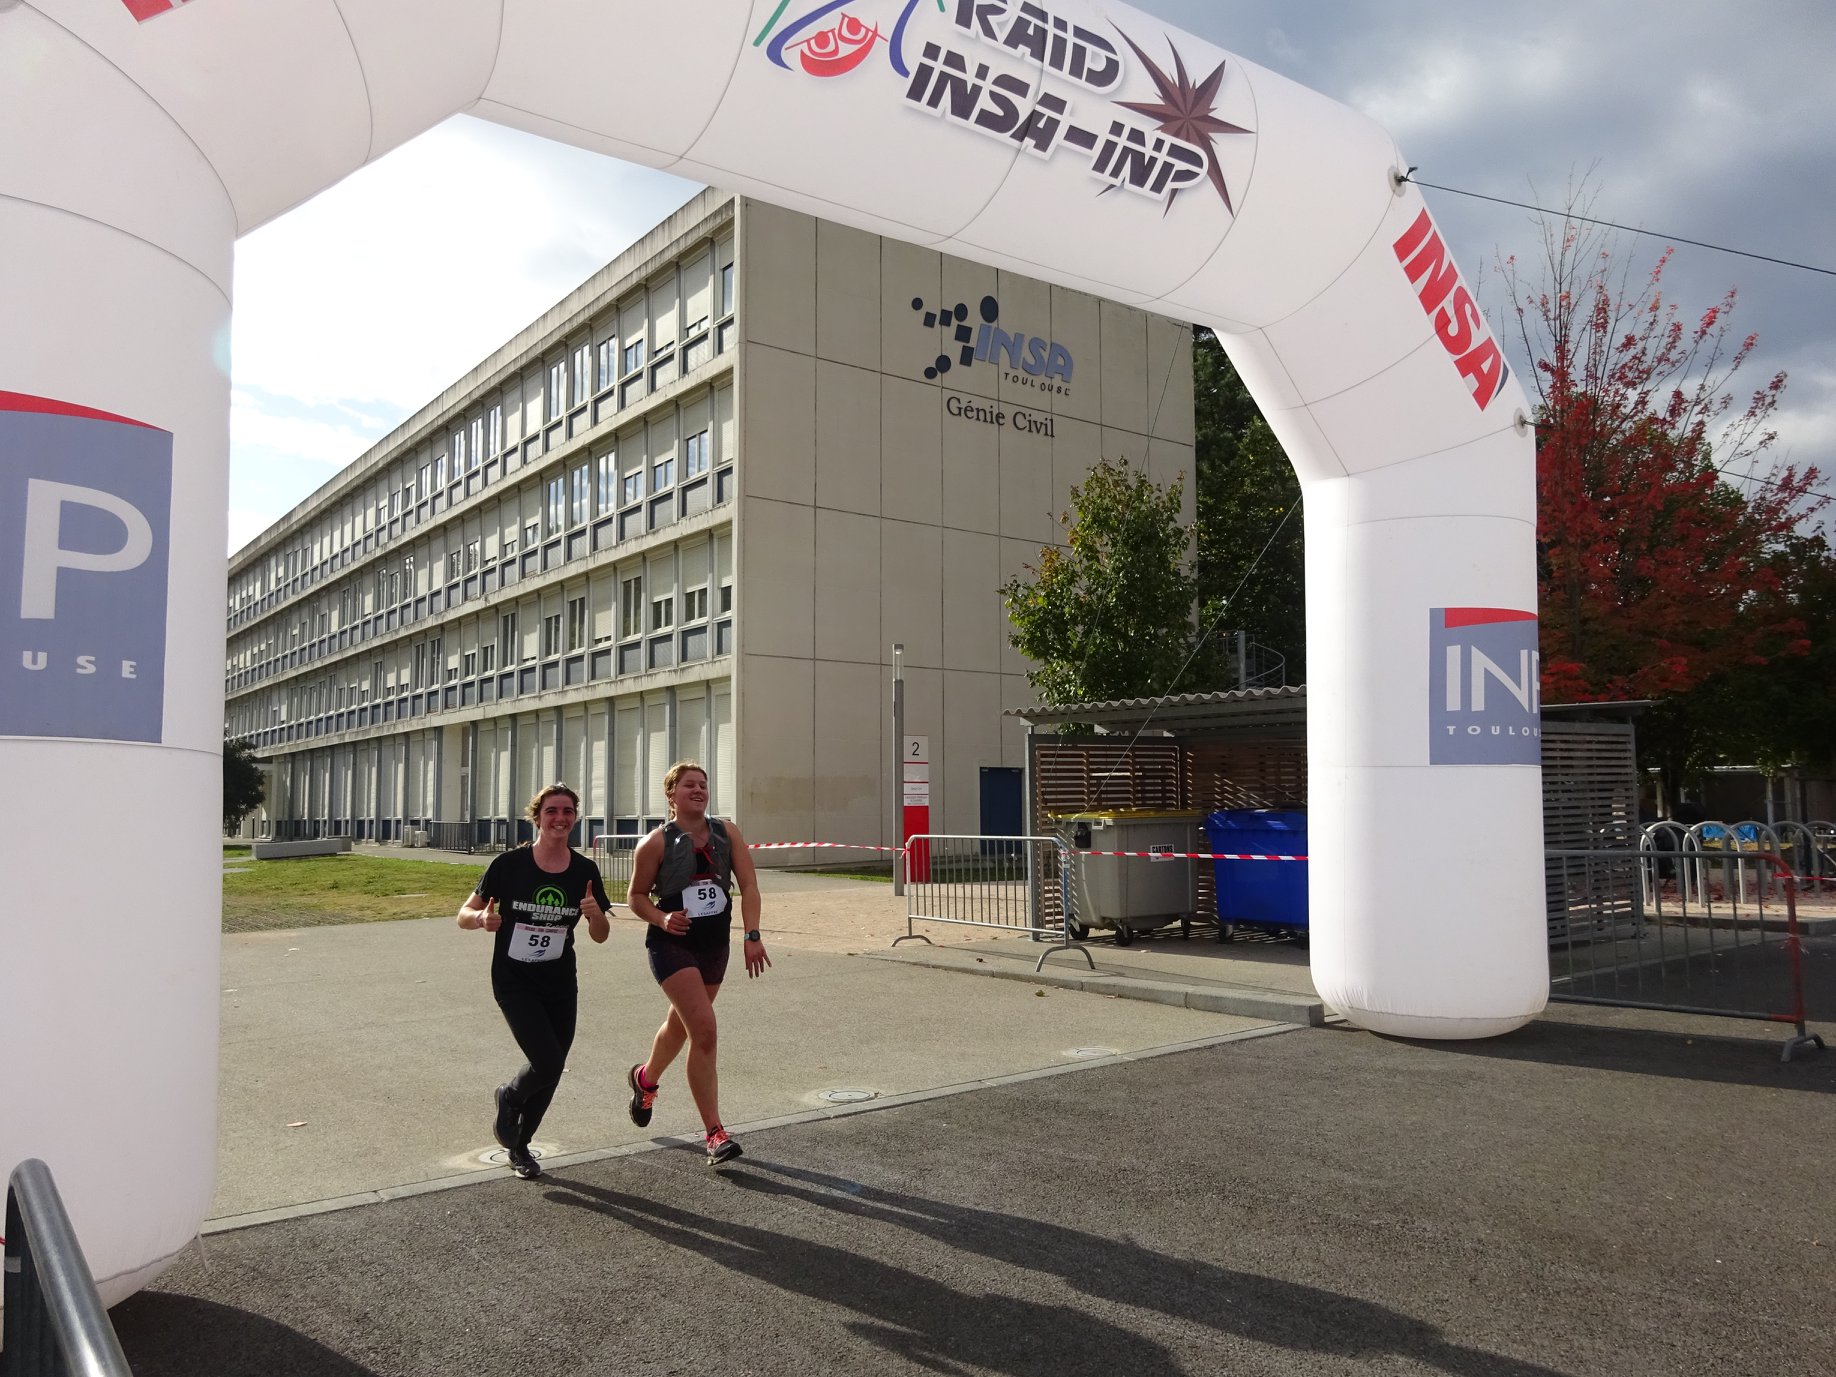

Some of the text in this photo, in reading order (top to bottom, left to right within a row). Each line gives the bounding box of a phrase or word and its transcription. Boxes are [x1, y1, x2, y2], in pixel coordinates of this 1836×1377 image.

[954, 0, 1121, 89] RAID
[1392, 206, 1502, 412] INSA
[974, 322, 1074, 384] INSA
[1003, 372, 1071, 397] TOULOUSE
[946, 396, 1055, 438] Génie Civil
[1446, 725, 1541, 737] TOULOU
[912, 741, 920, 756] 2
[698, 887, 717, 900] 58
[531, 912, 563, 922] SHOP
[528, 934, 551, 948] 58
